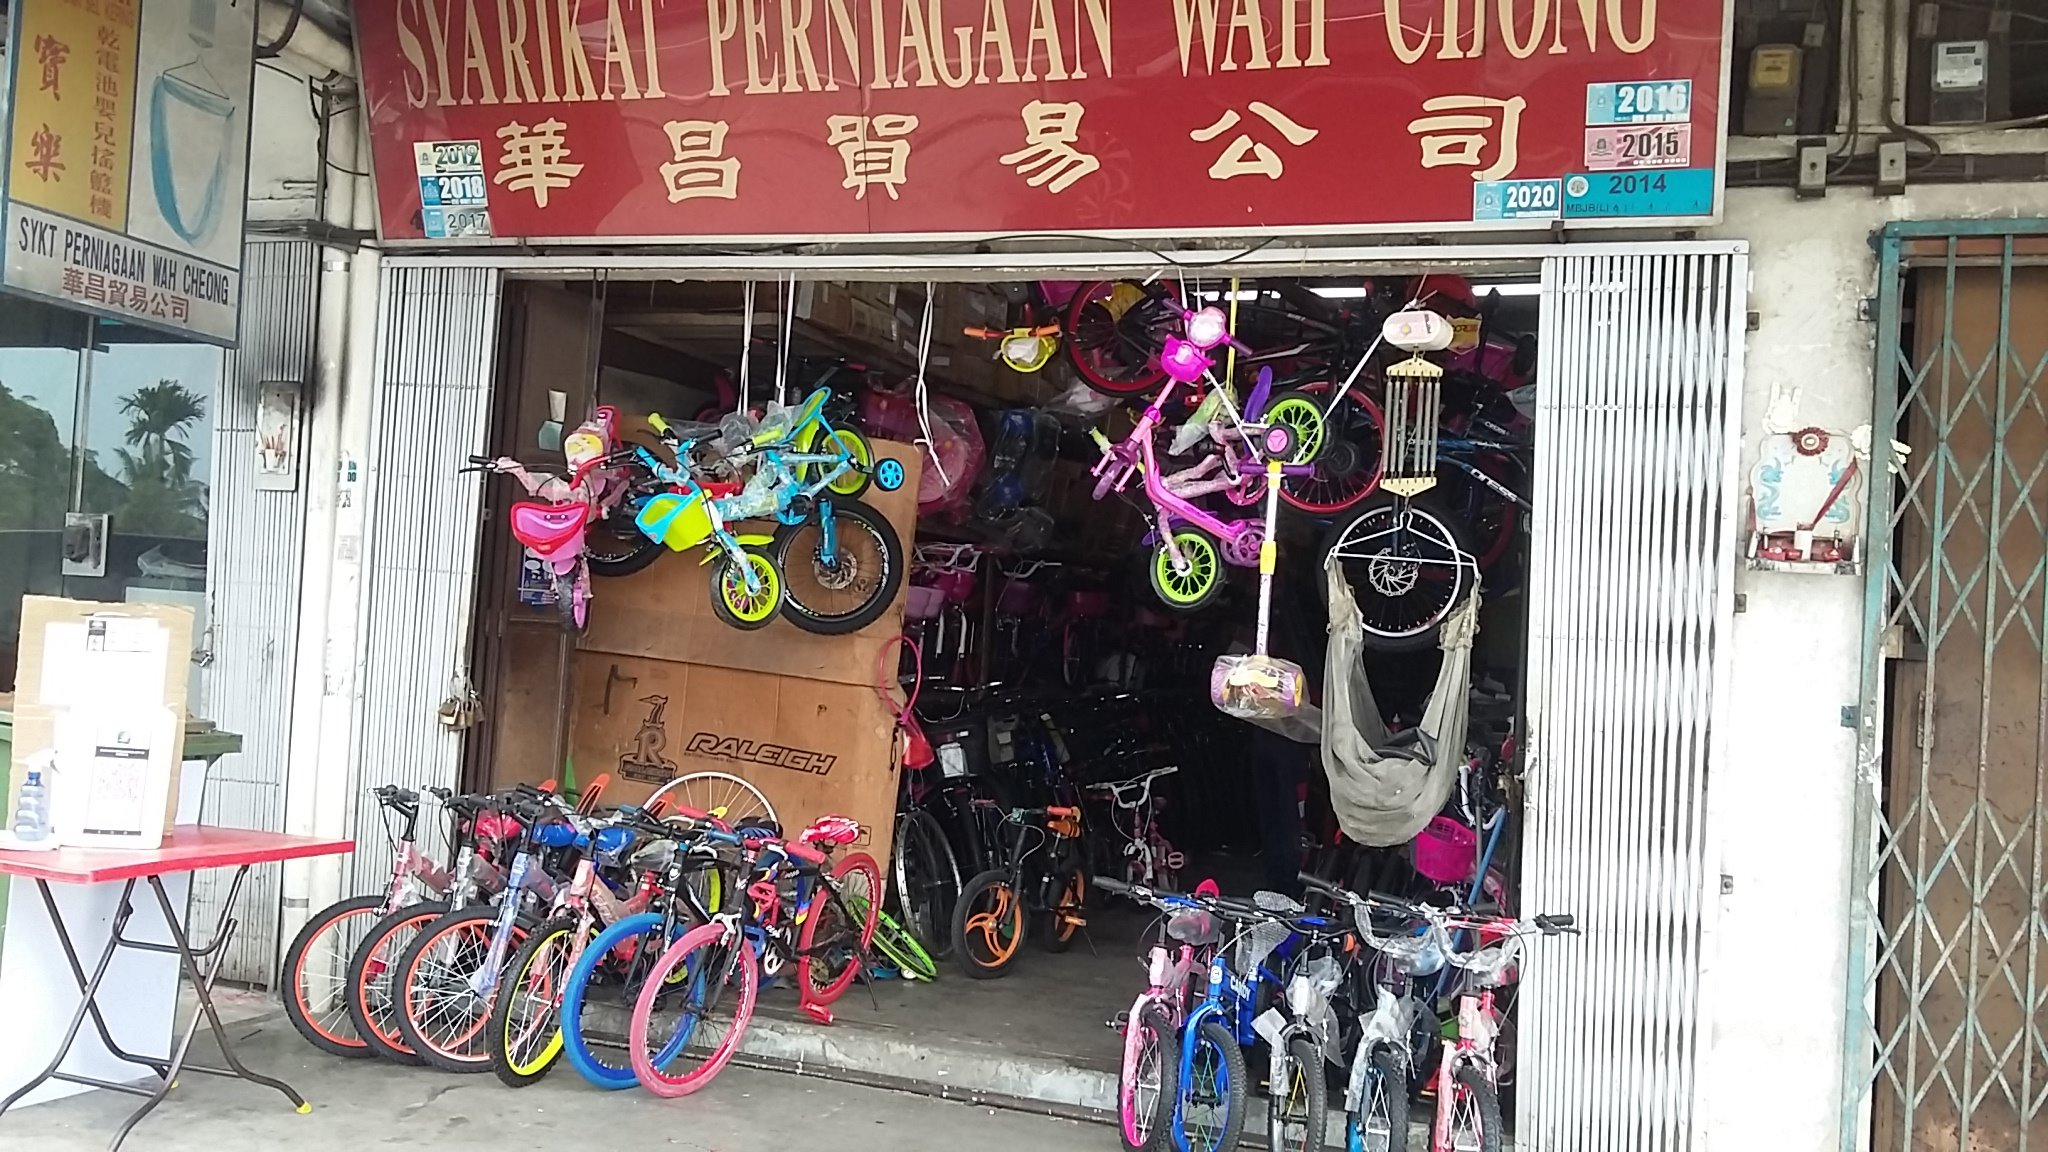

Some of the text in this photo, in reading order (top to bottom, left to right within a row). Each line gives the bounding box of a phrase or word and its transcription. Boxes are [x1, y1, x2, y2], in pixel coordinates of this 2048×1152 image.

[396, 0, 666, 109] SYARIKAT
[708, 0, 1112, 96] PERNIAGAAN
[1618, 85, 1687, 114] 2016
[434, 145, 479, 166] 2019
[1622, 132, 1680, 158] 2015
[438, 176, 485, 200] 2018
[1505, 185, 1556, 208] 2020
[1608, 173, 1667, 194] 2014
[447, 213, 487, 229] 2017
[19, 216, 230, 306] SYKT PERNIAGAAN WAH CHEONG
[62, 266, 190, 324] 華昌貿易公司
[685, 732, 838, 776] RALEIGH
